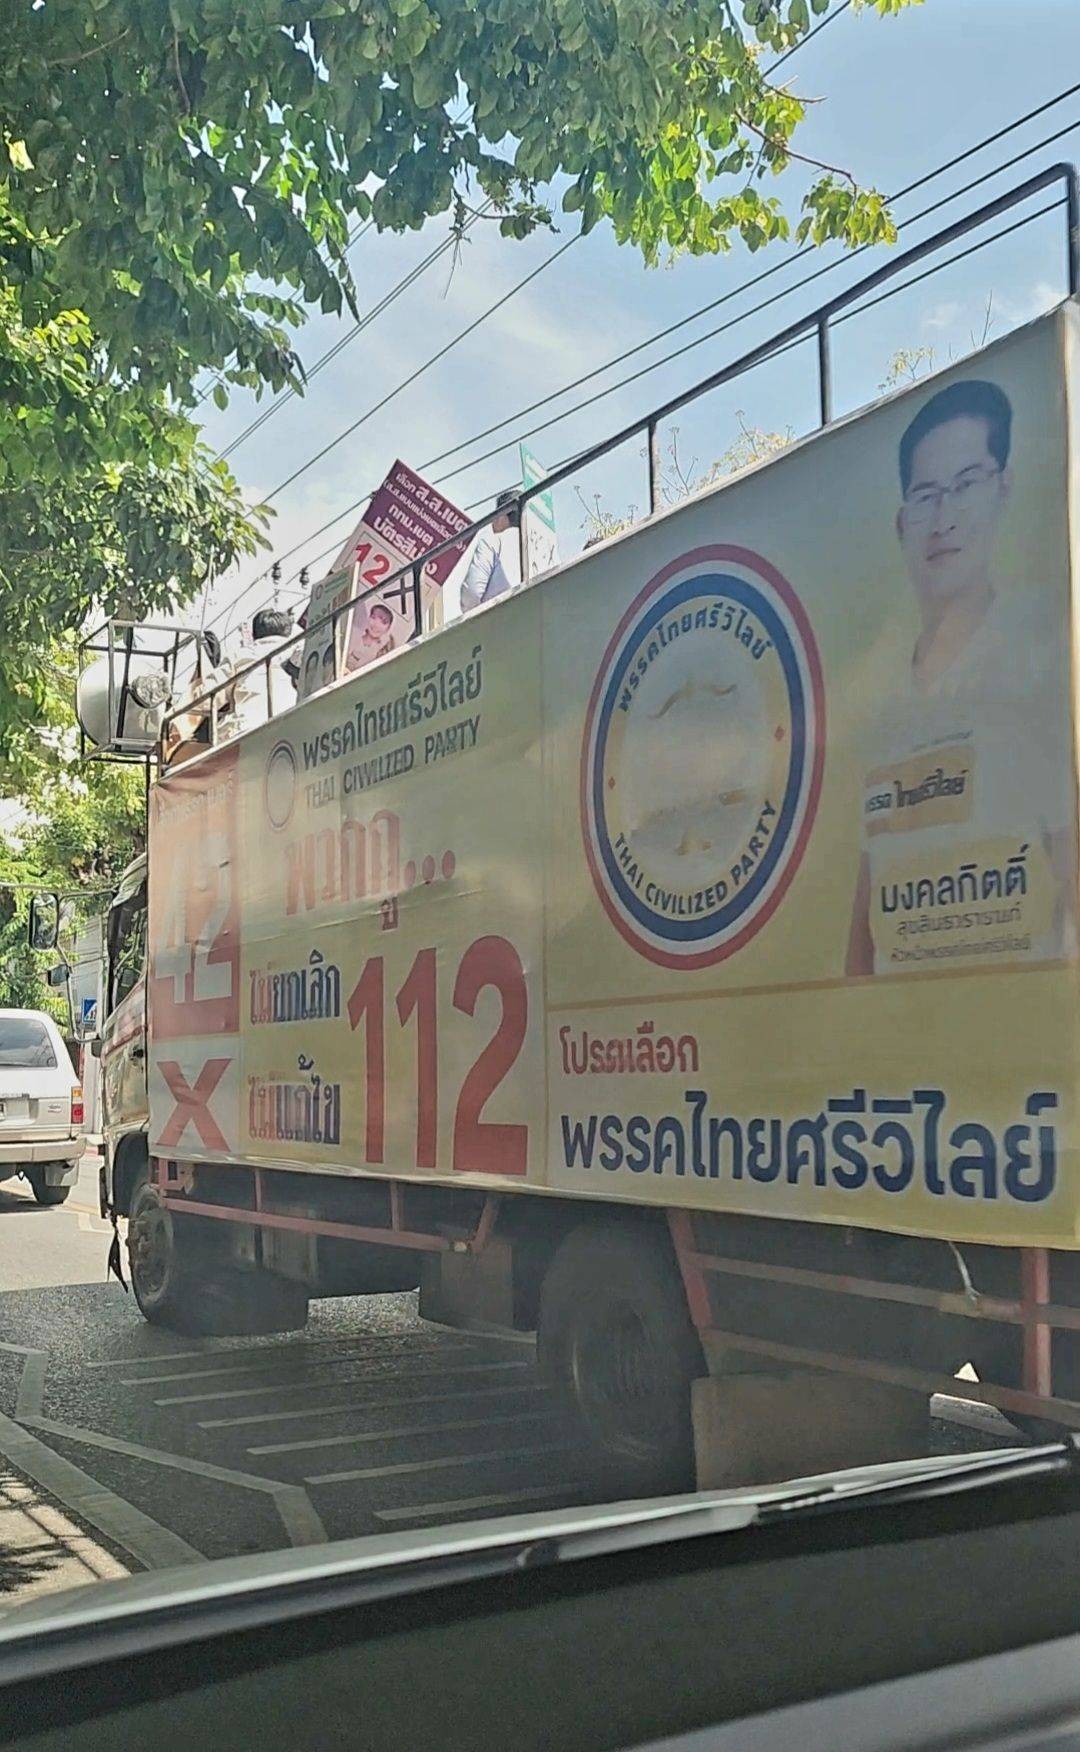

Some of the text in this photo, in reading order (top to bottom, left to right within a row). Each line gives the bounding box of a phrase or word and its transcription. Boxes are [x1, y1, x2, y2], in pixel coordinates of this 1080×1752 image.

[356, 542, 390, 586] 12
[373, 516, 438, 576] บัตรสีม่ง
[389, 503, 435, 547] กทม.เขต
[303, 646, 484, 770] พรรคไทยศรีวิไลย์
[304, 714, 481, 810] THAI CIVILIZED PARTY
[614, 800, 777, 916] THAI CIVILIZED PARTY
[880, 843, 1030, 914] มงคลกิตติ์
[347, 934, 528, 1176] 112
[558, 1020, 700, 1075] โปรดเลือก
[560, 1088, 1060, 1203] พรรคไทยศรีวิไลย์
